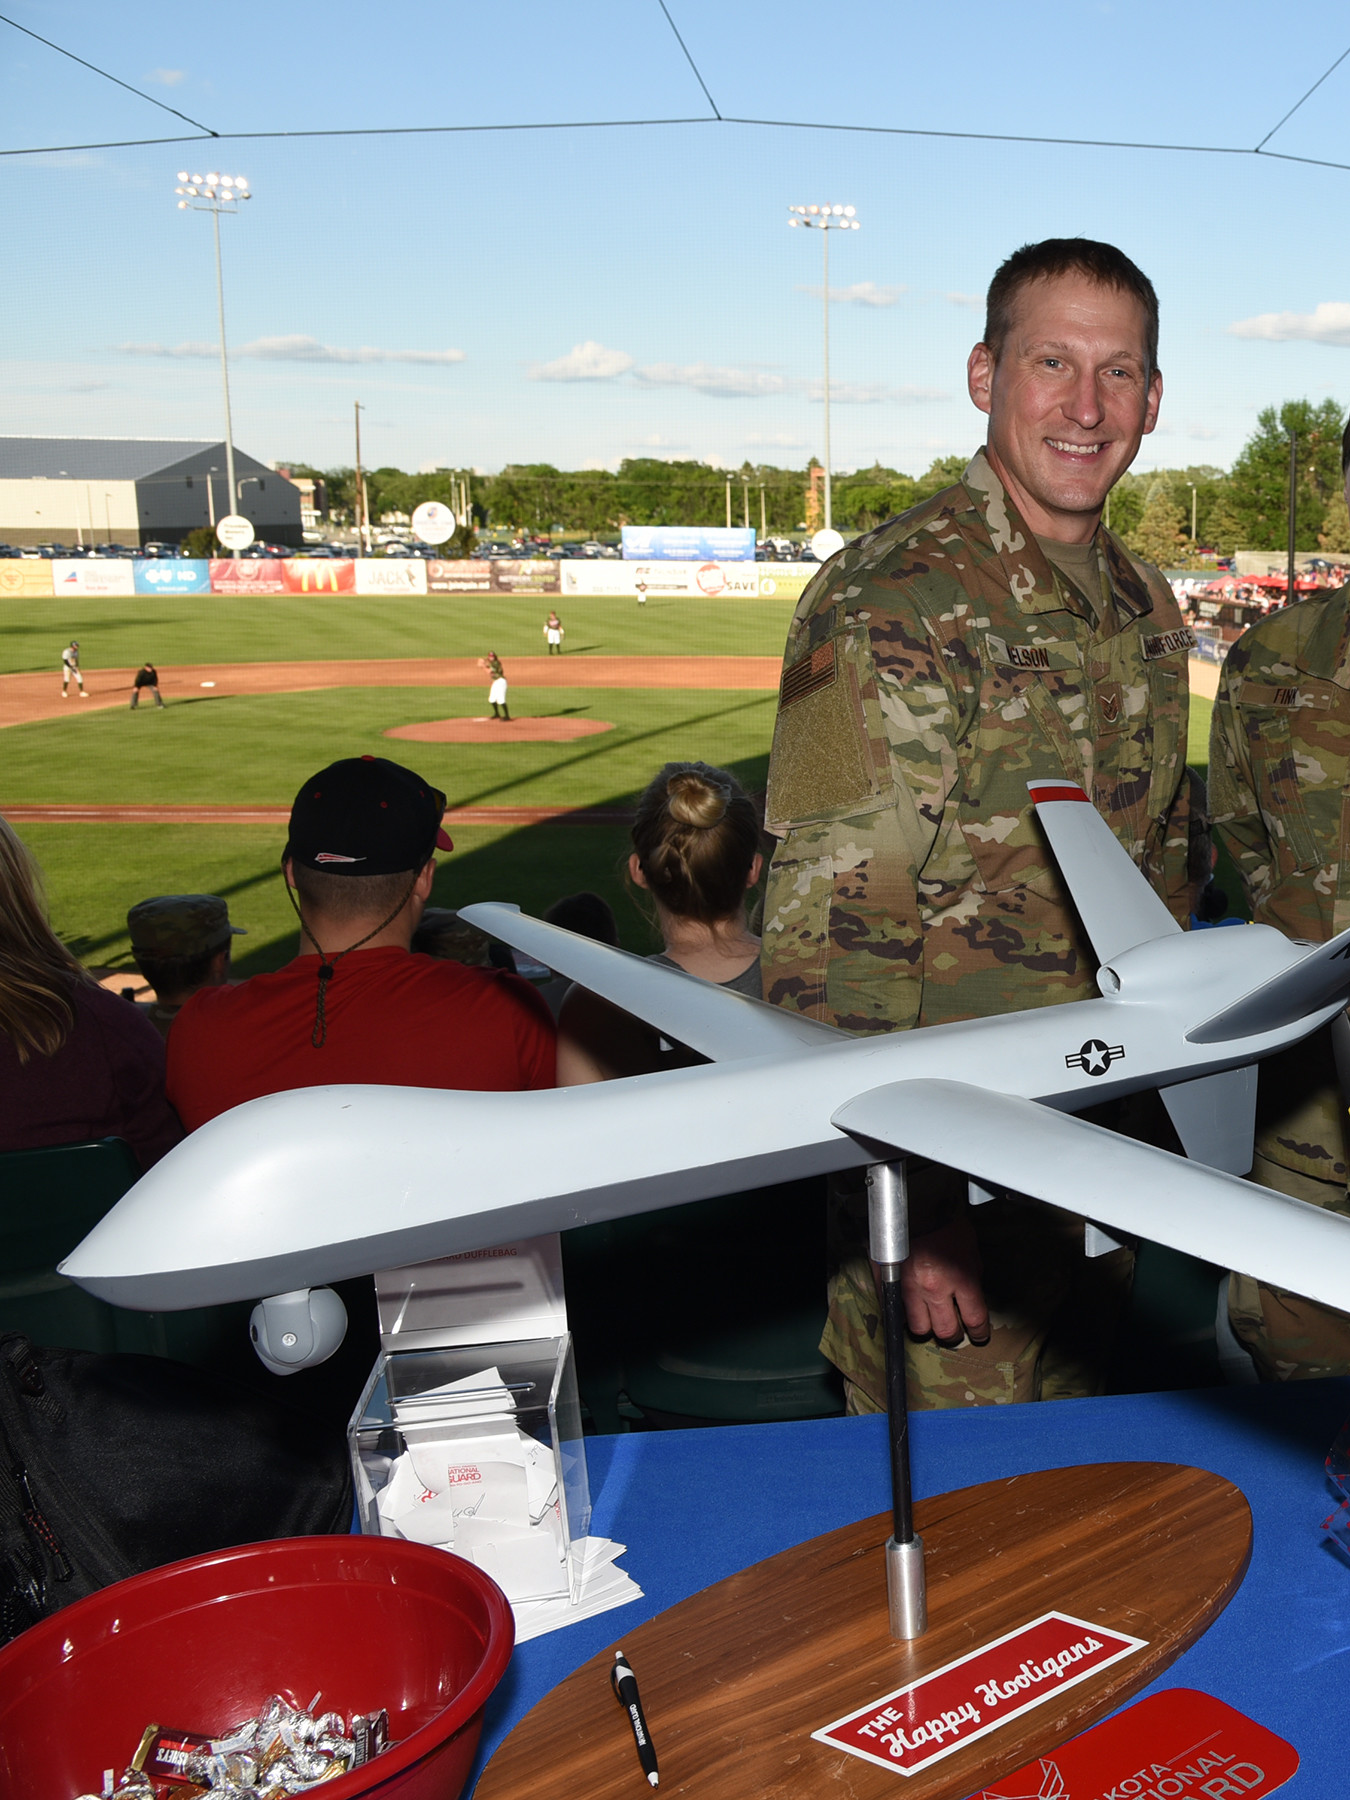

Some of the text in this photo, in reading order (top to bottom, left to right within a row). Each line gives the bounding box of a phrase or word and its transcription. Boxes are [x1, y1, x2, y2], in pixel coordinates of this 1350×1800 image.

[726, 582, 756, 591] SAVE
[463, 1248, 518, 1259] DUFFLEBAG
[880, 1635, 1105, 1757] Happy Hooligans
[857, 1705, 904, 1740] THE
